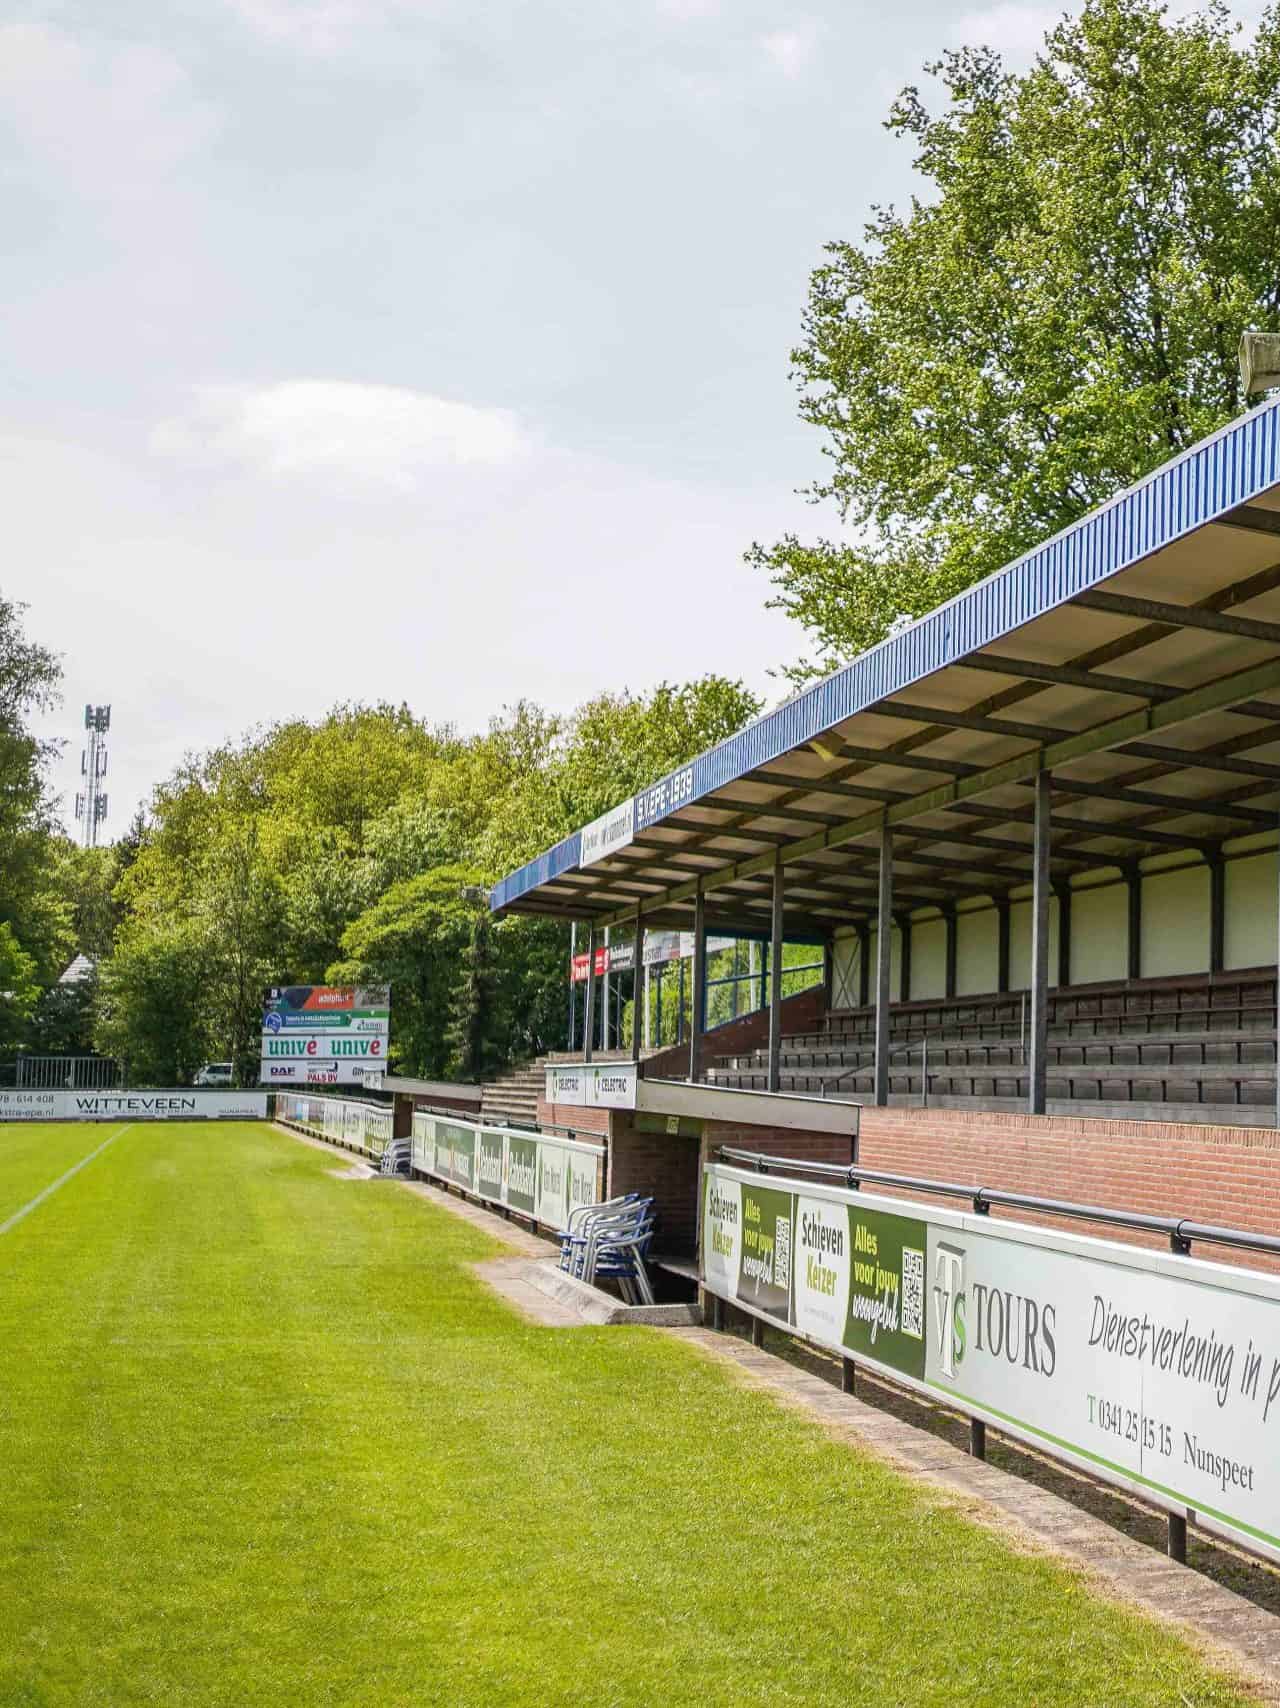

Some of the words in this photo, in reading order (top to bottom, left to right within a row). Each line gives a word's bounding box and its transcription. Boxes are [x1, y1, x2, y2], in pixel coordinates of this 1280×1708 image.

[77, 1098, 196, 1109] WITTEVEEN
[709, 1187, 738, 1225] Schieven
[745, 1198, 761, 1224] Alles
[744, 1230, 759, 1248] voor
[758, 1229, 774, 1256] jouw
[802, 1208, 843, 1257] Schieven
[854, 1223, 878, 1256] Alles
[806, 1252, 838, 1297] Keizer
[854, 1261, 875, 1287] voor
[875, 1260, 899, 1296] jouw
[973, 1283, 1056, 1378] TOURS
[1088, 1295, 1234, 1408] Dienstverlening
[1240, 1337, 1262, 1401] in
[1087, 1392, 1096, 1425] T
[1099, 1399, 1122, 1437] 0341
[1125, 1408, 1138, 1443] 25
[1142, 1415, 1155, 1449] 15
[1159, 1423, 1172, 1457] 15
[1183, 1431, 1254, 1493] Nunspeet
